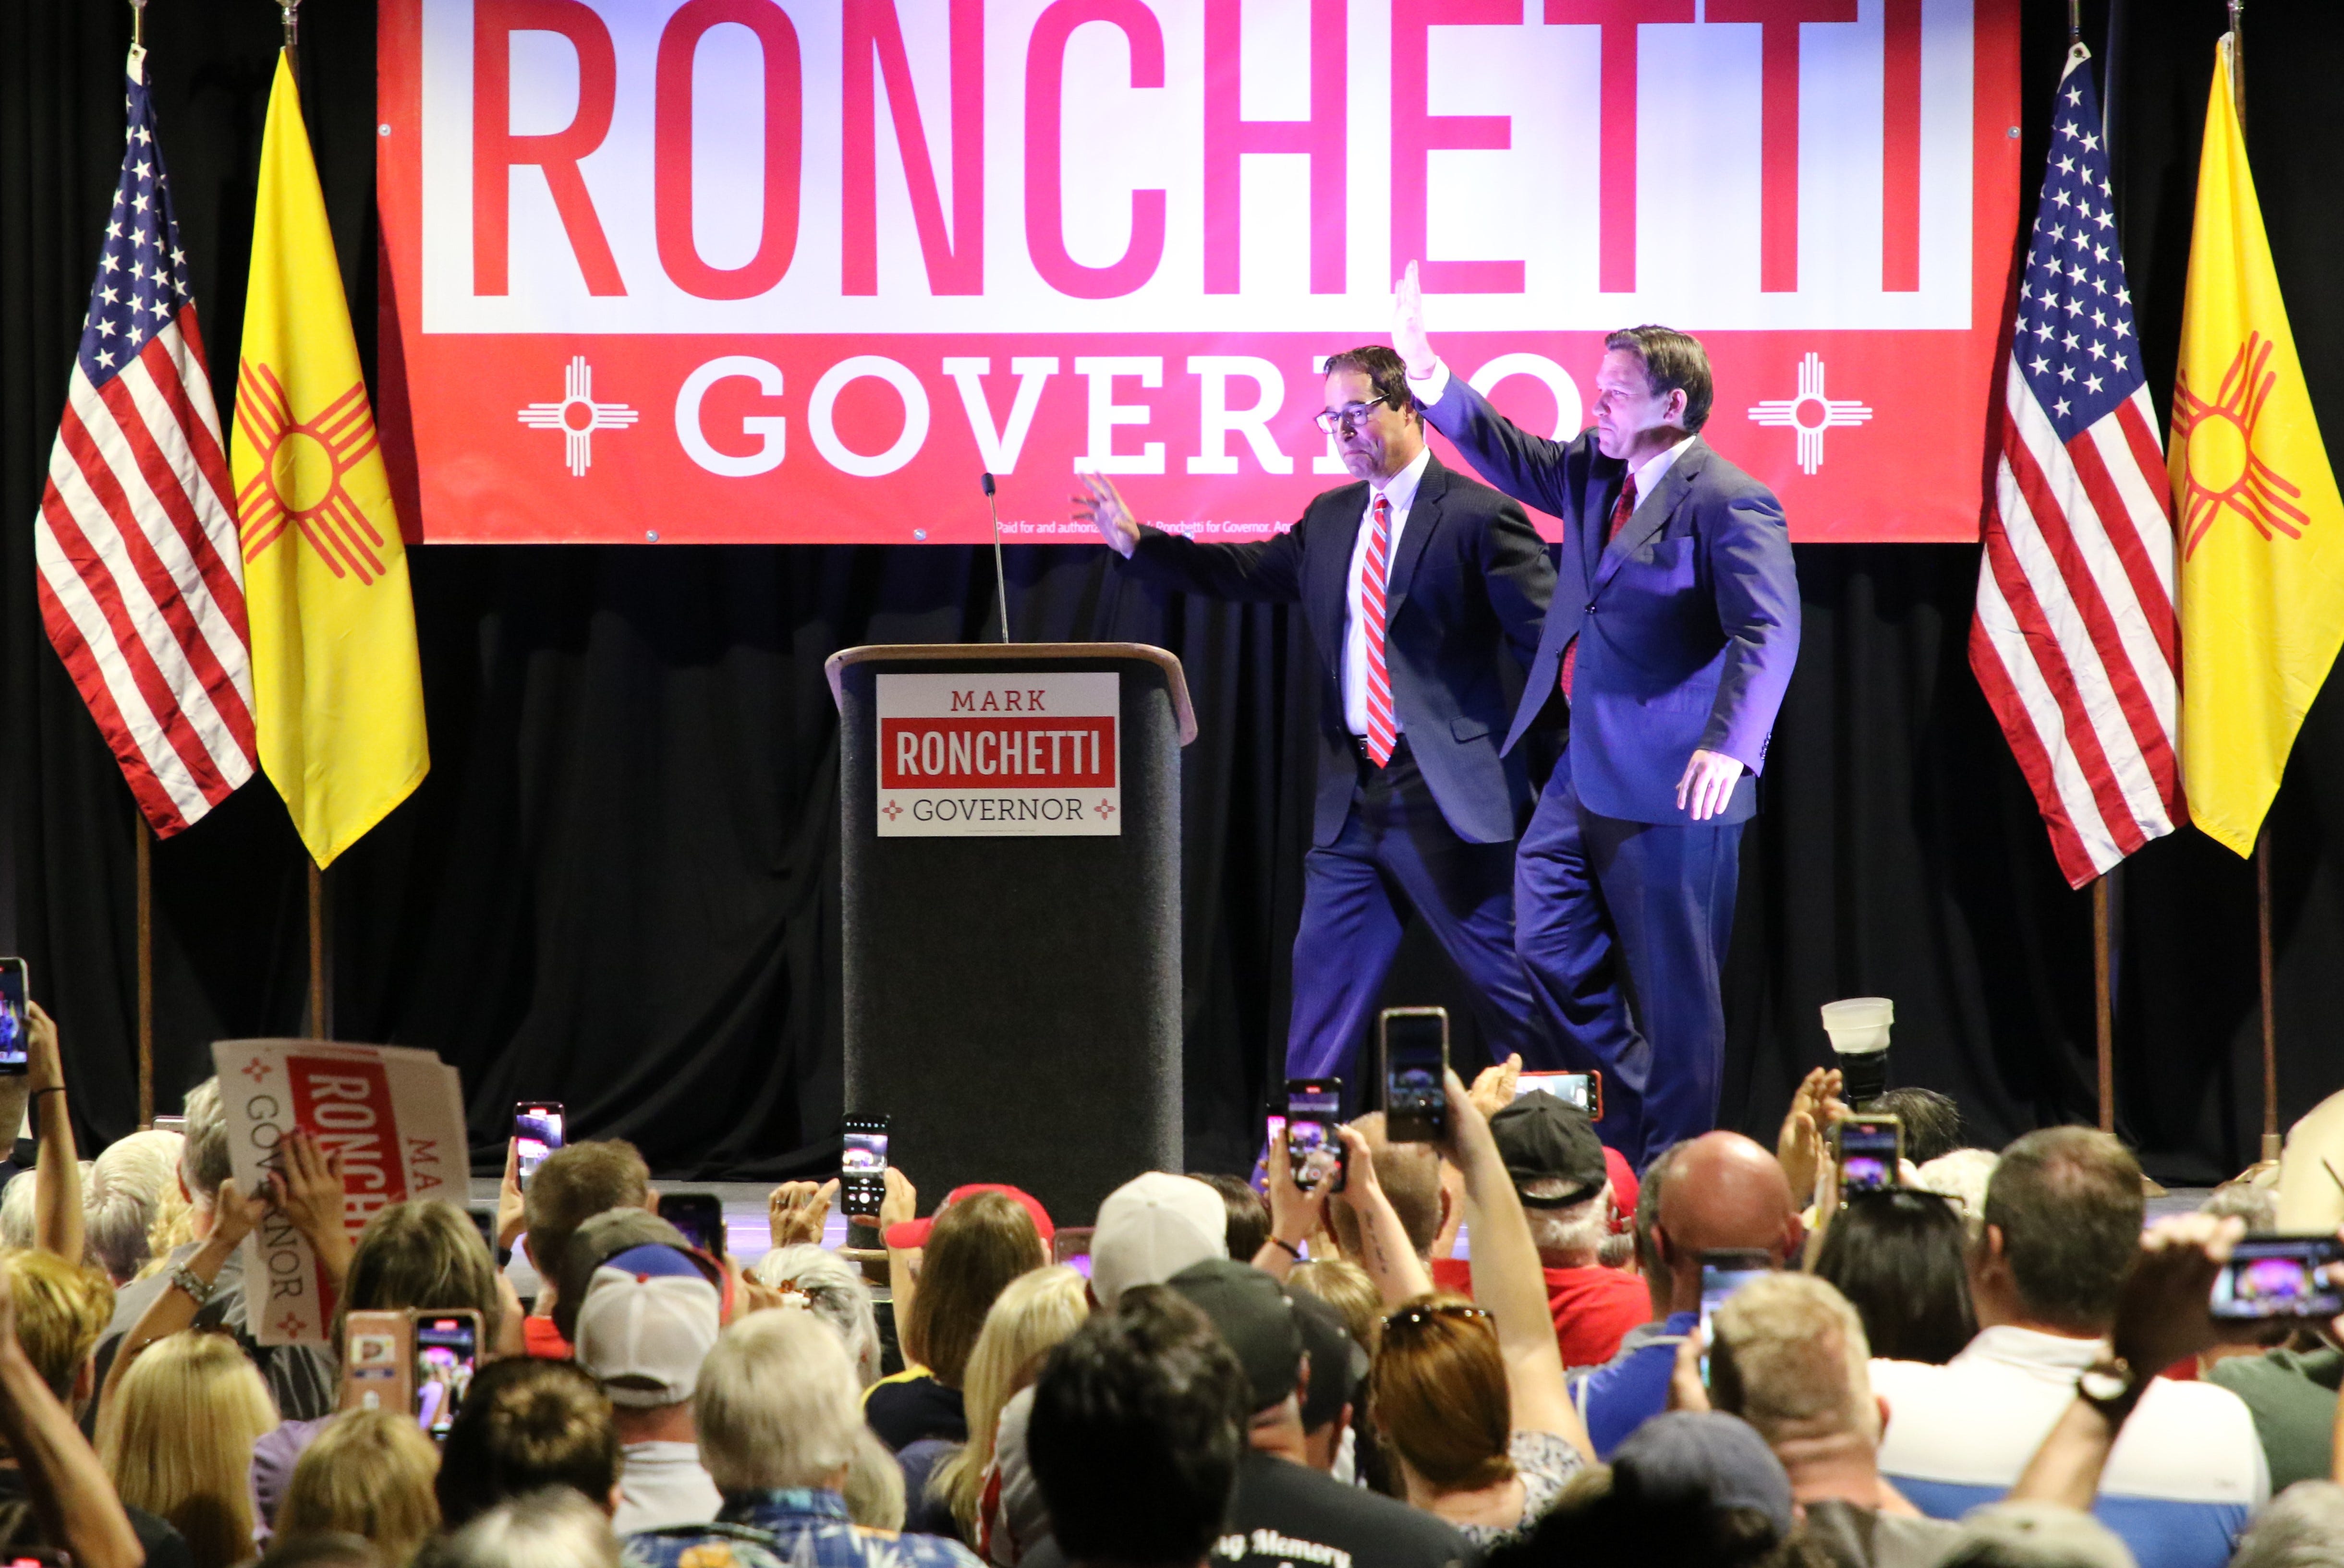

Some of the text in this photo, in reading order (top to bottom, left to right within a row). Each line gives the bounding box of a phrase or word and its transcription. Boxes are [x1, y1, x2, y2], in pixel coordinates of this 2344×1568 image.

[472, 0, 1921, 301] RONCHETTI
[675, 353, 1583, 477] GOVERO
[996, 521, 1018, 533] Paid
[1020, 520, 1035, 533] for
[1036, 521, 1056, 533] and
[1057, 521, 1100, 533] authoriz
[1206, 521, 1221, 532] for
[1223, 521, 1272, 533] Governor.
[950, 690, 1046, 712] MARK
[897, 730, 1100, 776] RONCHETTI
[913, 798, 1083, 821] GOVERNOR
[308, 1074, 389, 1237] RONCH
[407, 1136, 443, 1192] MA
